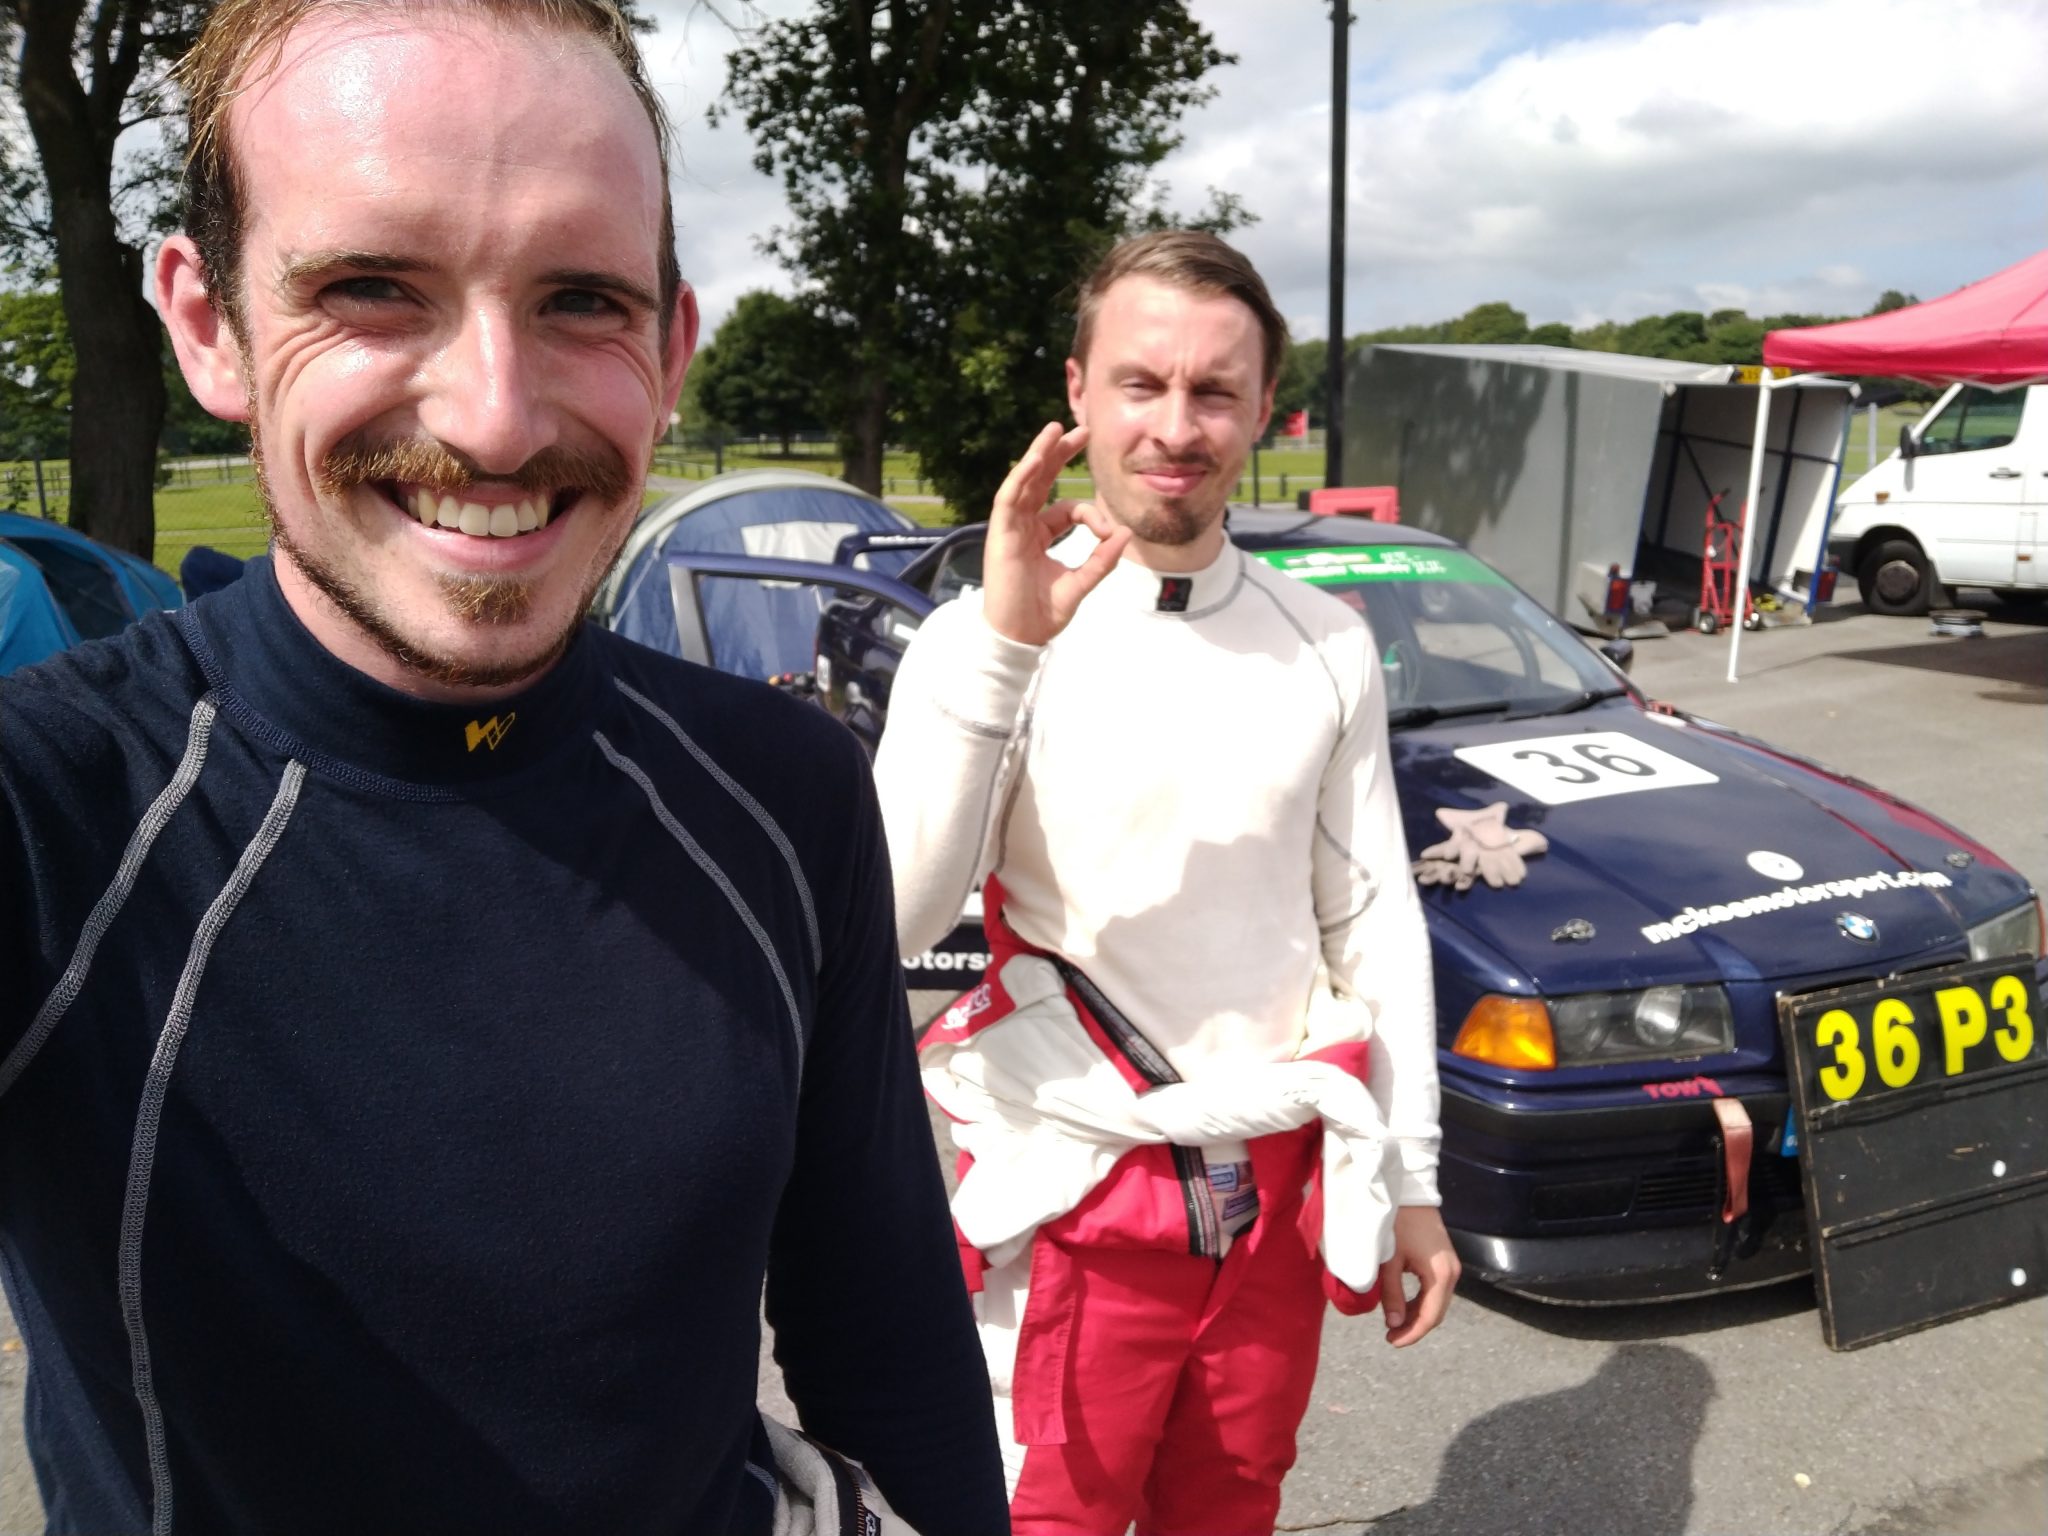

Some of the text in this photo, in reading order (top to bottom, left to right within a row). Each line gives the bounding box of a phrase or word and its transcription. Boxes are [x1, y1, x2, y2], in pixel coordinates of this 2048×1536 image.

[1513, 744, 1656, 783] 36
[1816, 975, 2034, 1101] 36 P3
[1642, 1079, 1701, 1098] TOW
